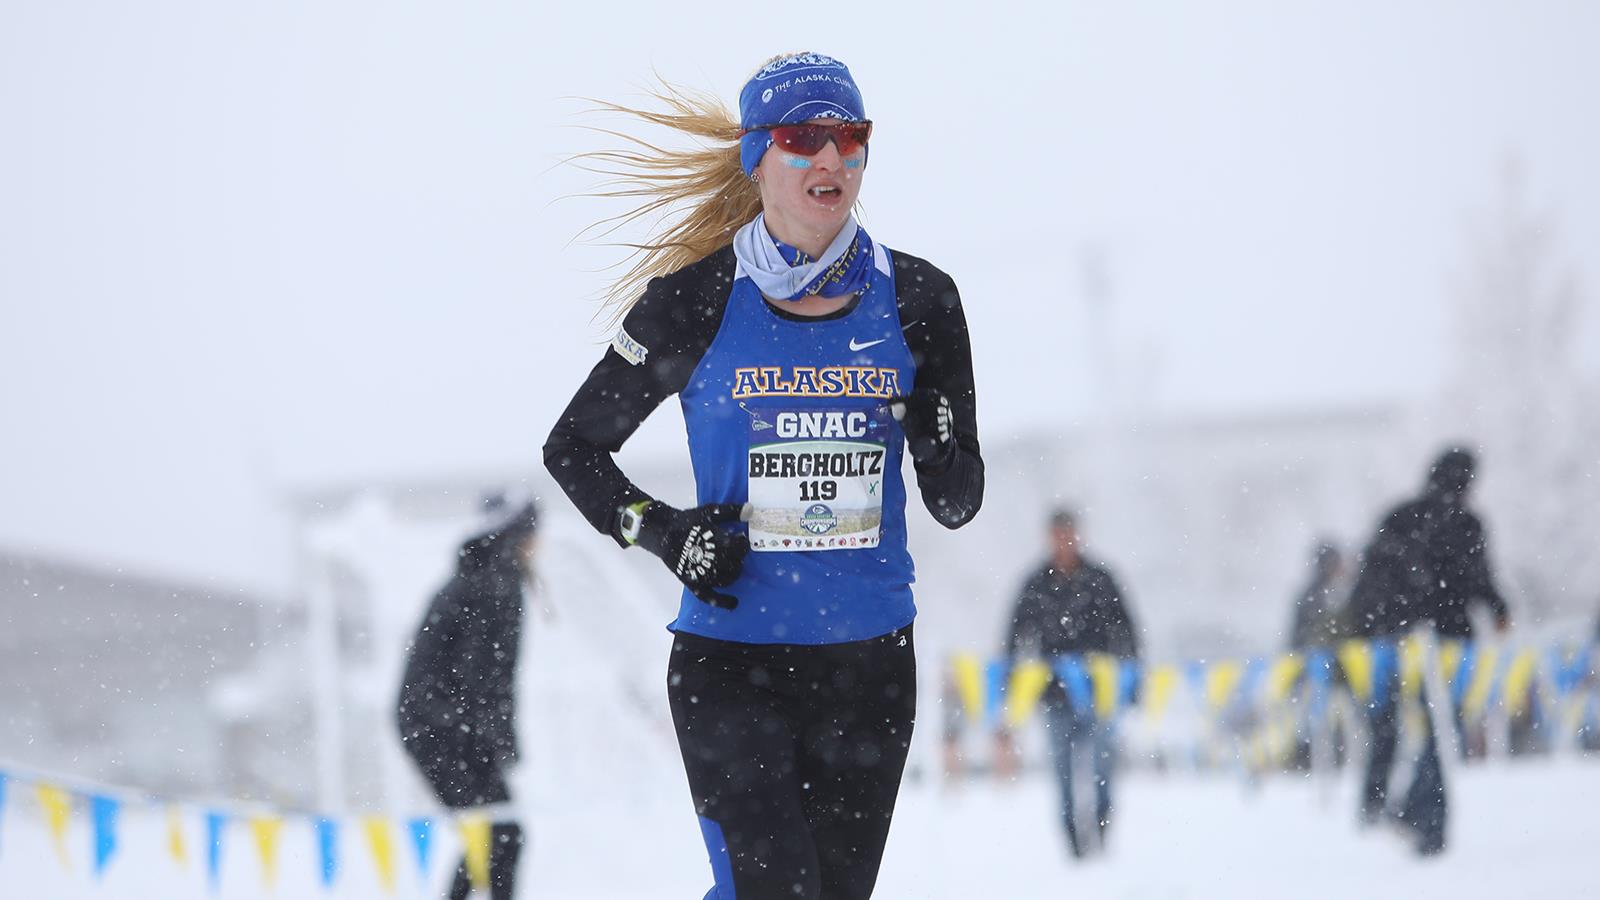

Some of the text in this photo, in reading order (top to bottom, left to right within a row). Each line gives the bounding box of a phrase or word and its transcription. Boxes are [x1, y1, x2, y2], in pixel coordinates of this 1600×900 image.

[775, 80, 791, 93] THE
[794, 73, 831, 85] ALASKA
[733, 367, 901, 399] ALASKA
[776, 412, 867, 438] GNAC
[749, 450, 884, 478] BERGHOLTZ
[799, 480, 838, 502] 119
